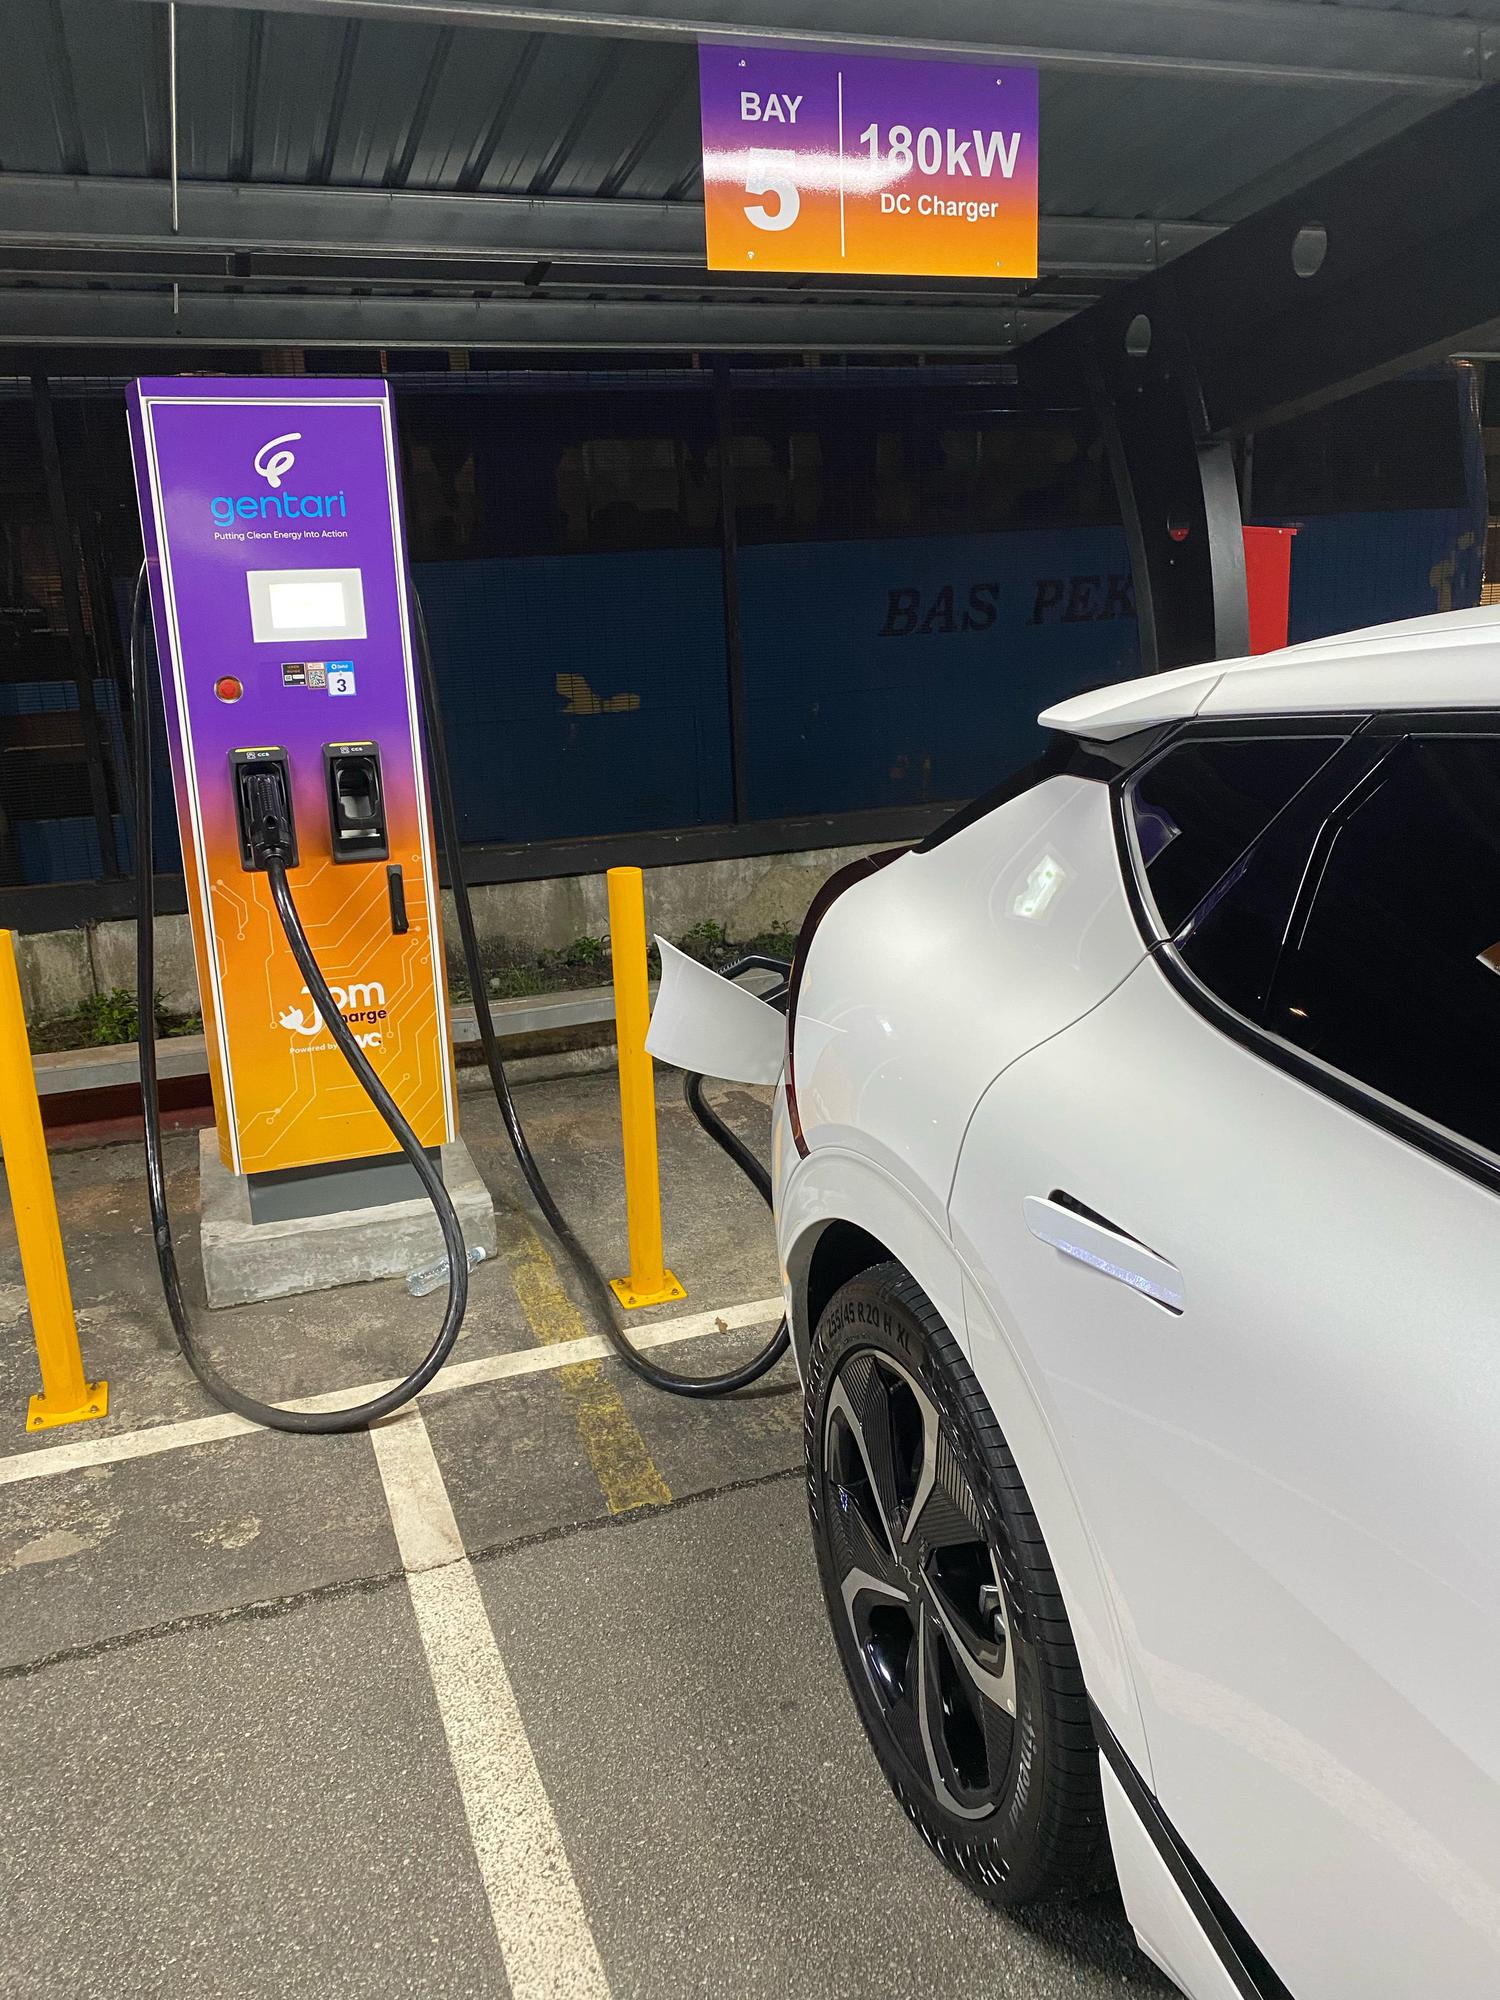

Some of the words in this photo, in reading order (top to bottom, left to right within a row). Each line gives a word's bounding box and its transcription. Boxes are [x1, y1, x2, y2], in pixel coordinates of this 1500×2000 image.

[740, 91, 803, 124] BAY
[859, 123, 1021, 179] 180kW
[743, 147, 801, 232] 5
[880, 193, 911, 215] DC
[917, 194, 999, 222] Charger
[210, 491, 347, 527] gentari
[214, 531, 245, 541] Putting
[246, 530, 272, 539] Clean
[273, 530, 302, 541] Energy
[303, 530, 320, 538] Into
[321, 529, 348, 538] Action
[877, 582, 1000, 637] BAS
[336, 678, 347, 692] 3
[340, 1009, 387, 1024] arge
[289, 1043, 326, 1054] Powered
[327, 1042, 338, 1051] by
[897, 1323, 912, 1356] XL
